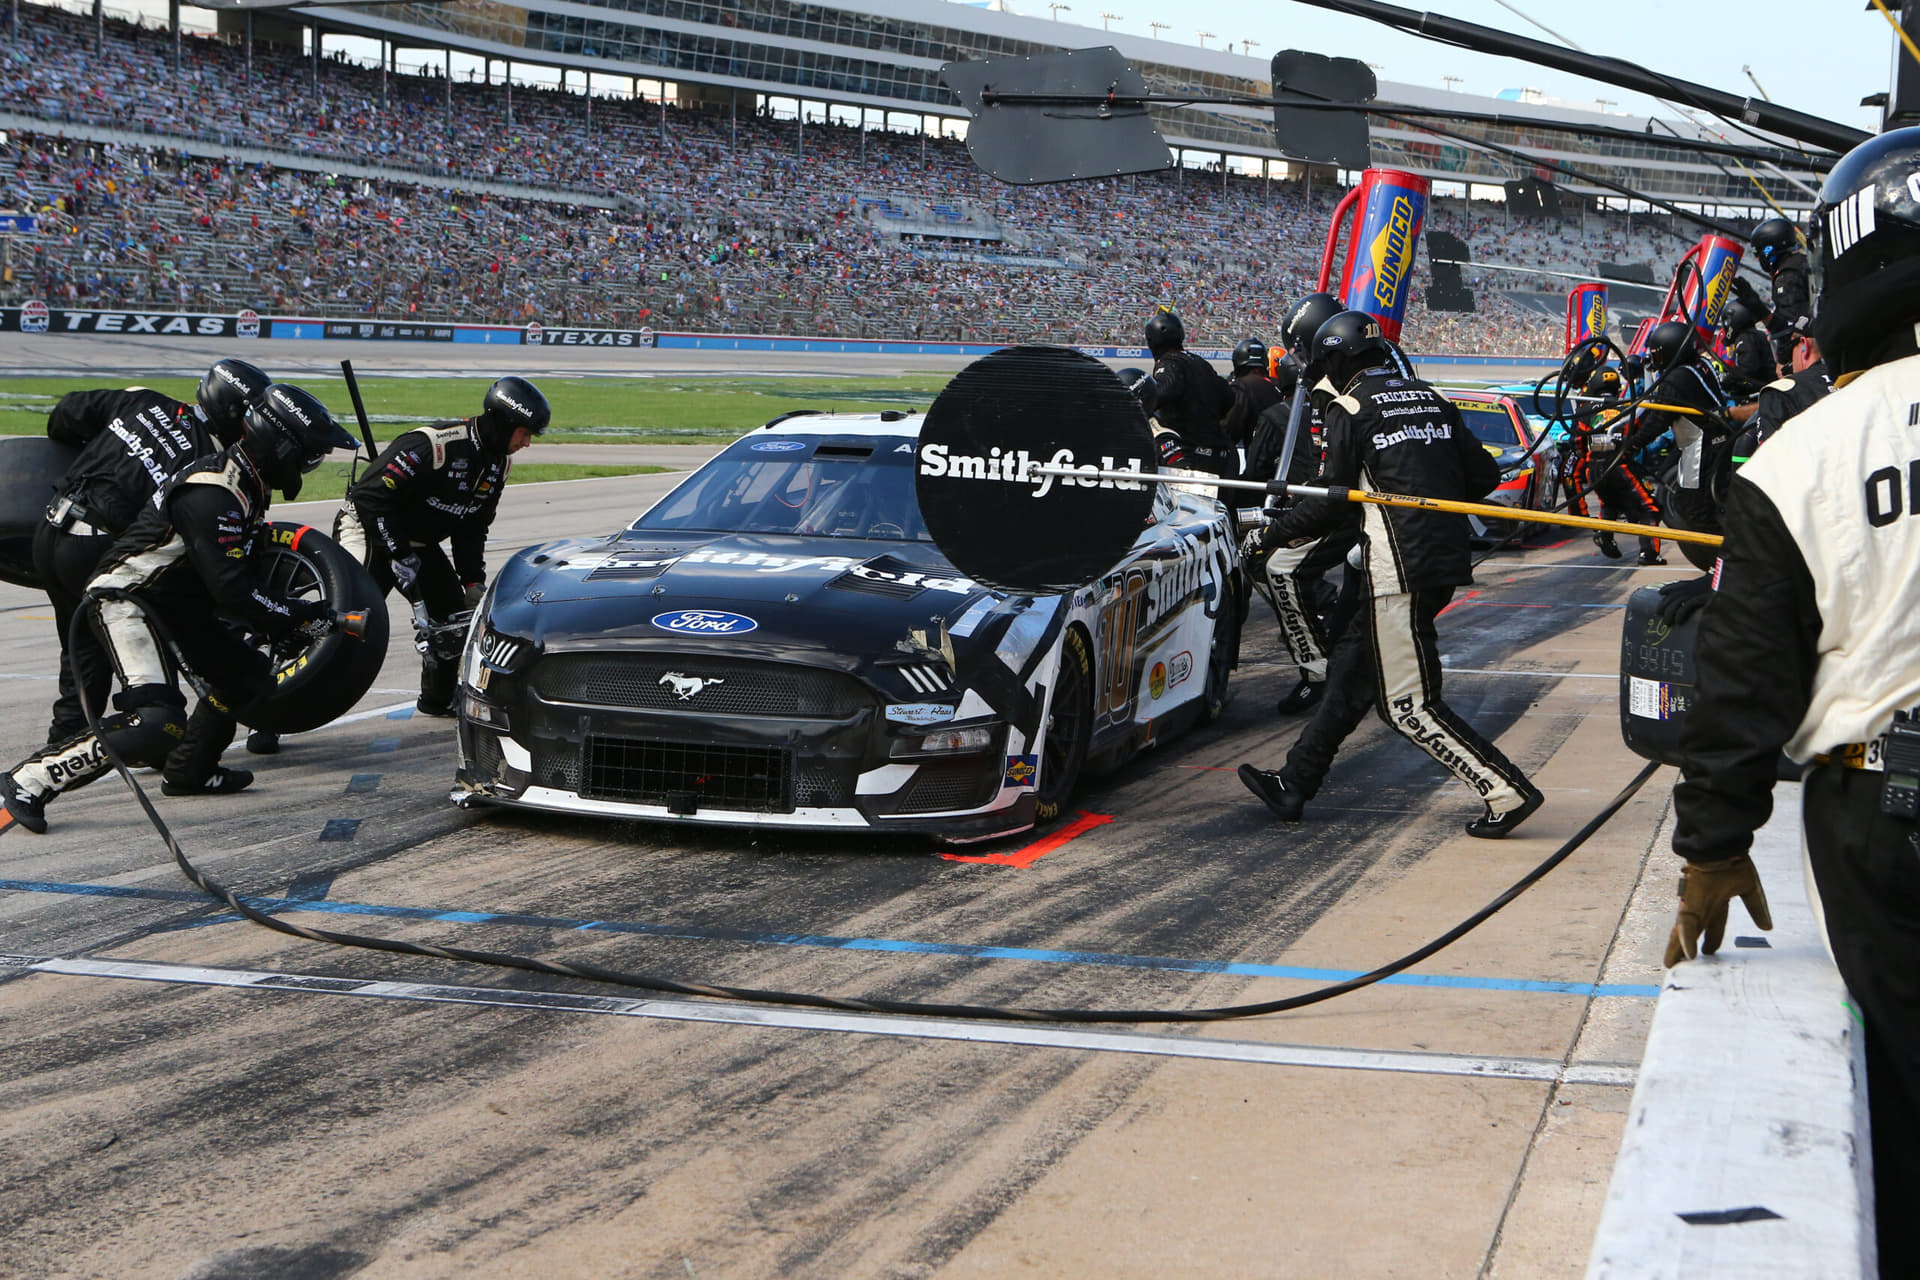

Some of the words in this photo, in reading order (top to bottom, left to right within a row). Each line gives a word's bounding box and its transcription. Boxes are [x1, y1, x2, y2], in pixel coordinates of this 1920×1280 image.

[1376, 195, 1413, 307] SUNOCO
[1706, 258, 1736, 327] SUNOCO
[62, 312, 225, 335] TEXAS
[1365, 322, 1380, 339] 10
[1592, 297, 1603, 336] UNOCO
[547, 331, 632, 346] TEXAS
[1116, 348, 1142, 357] GEICO
[214, 365, 250, 394] Smithfield
[272, 389, 312, 427] Smithfield
[496, 390, 533, 418] Smithfield
[1371, 391, 1434, 405] TRICKETT
[1382, 405, 1441, 418] Smithfield.com
[1372, 421, 1453, 450] Smithfiel
[108, 418, 169, 487] Smithfield
[919, 444, 1142, 498] Smithfield
[669, 611, 735, 632] Ford
[1271, 573, 1317, 664] Smithfield
[476, 666, 491, 690] 10
[1394, 694, 1495, 797] Smithfield
